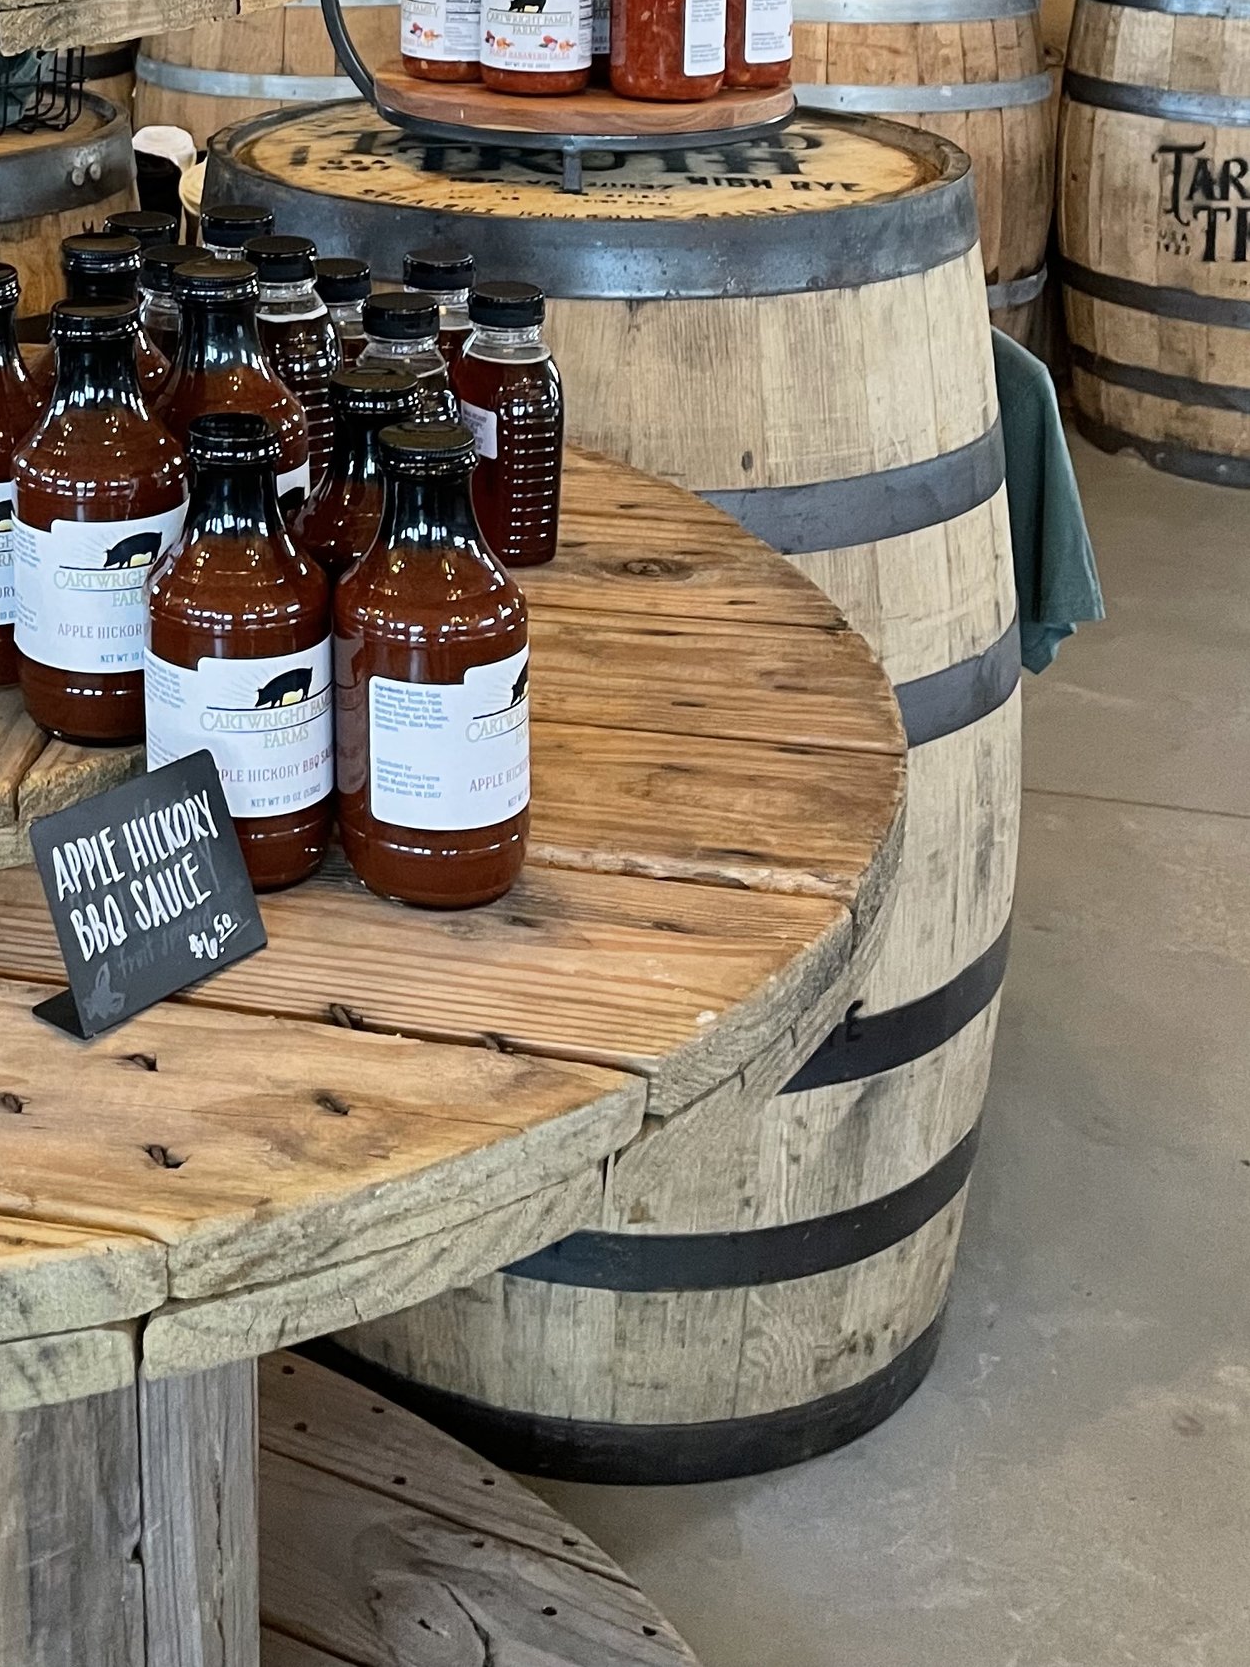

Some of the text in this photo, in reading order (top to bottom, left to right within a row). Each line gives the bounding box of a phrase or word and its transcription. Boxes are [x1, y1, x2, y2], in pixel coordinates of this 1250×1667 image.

[544, 13, 574, 25] FAMILY
[686, 176, 773, 189] HIGH
[789, 180, 864, 192] RYE
[58, 623, 142, 639] APPLE HICKOR
[200, 704, 308, 731] CARTWRIGHT
[262, 725, 309, 749] FARMS
[248, 753, 319, 783] HICKORY BBQ
[469, 772, 504, 793] APPLE
[251, 798, 266, 808] NET
[268, 795, 279, 806] WT
[52, 790, 219, 902] APPLE HICKORY
[70, 894, 128, 962] BBQ
[129, 852, 212, 931] SAUCE
